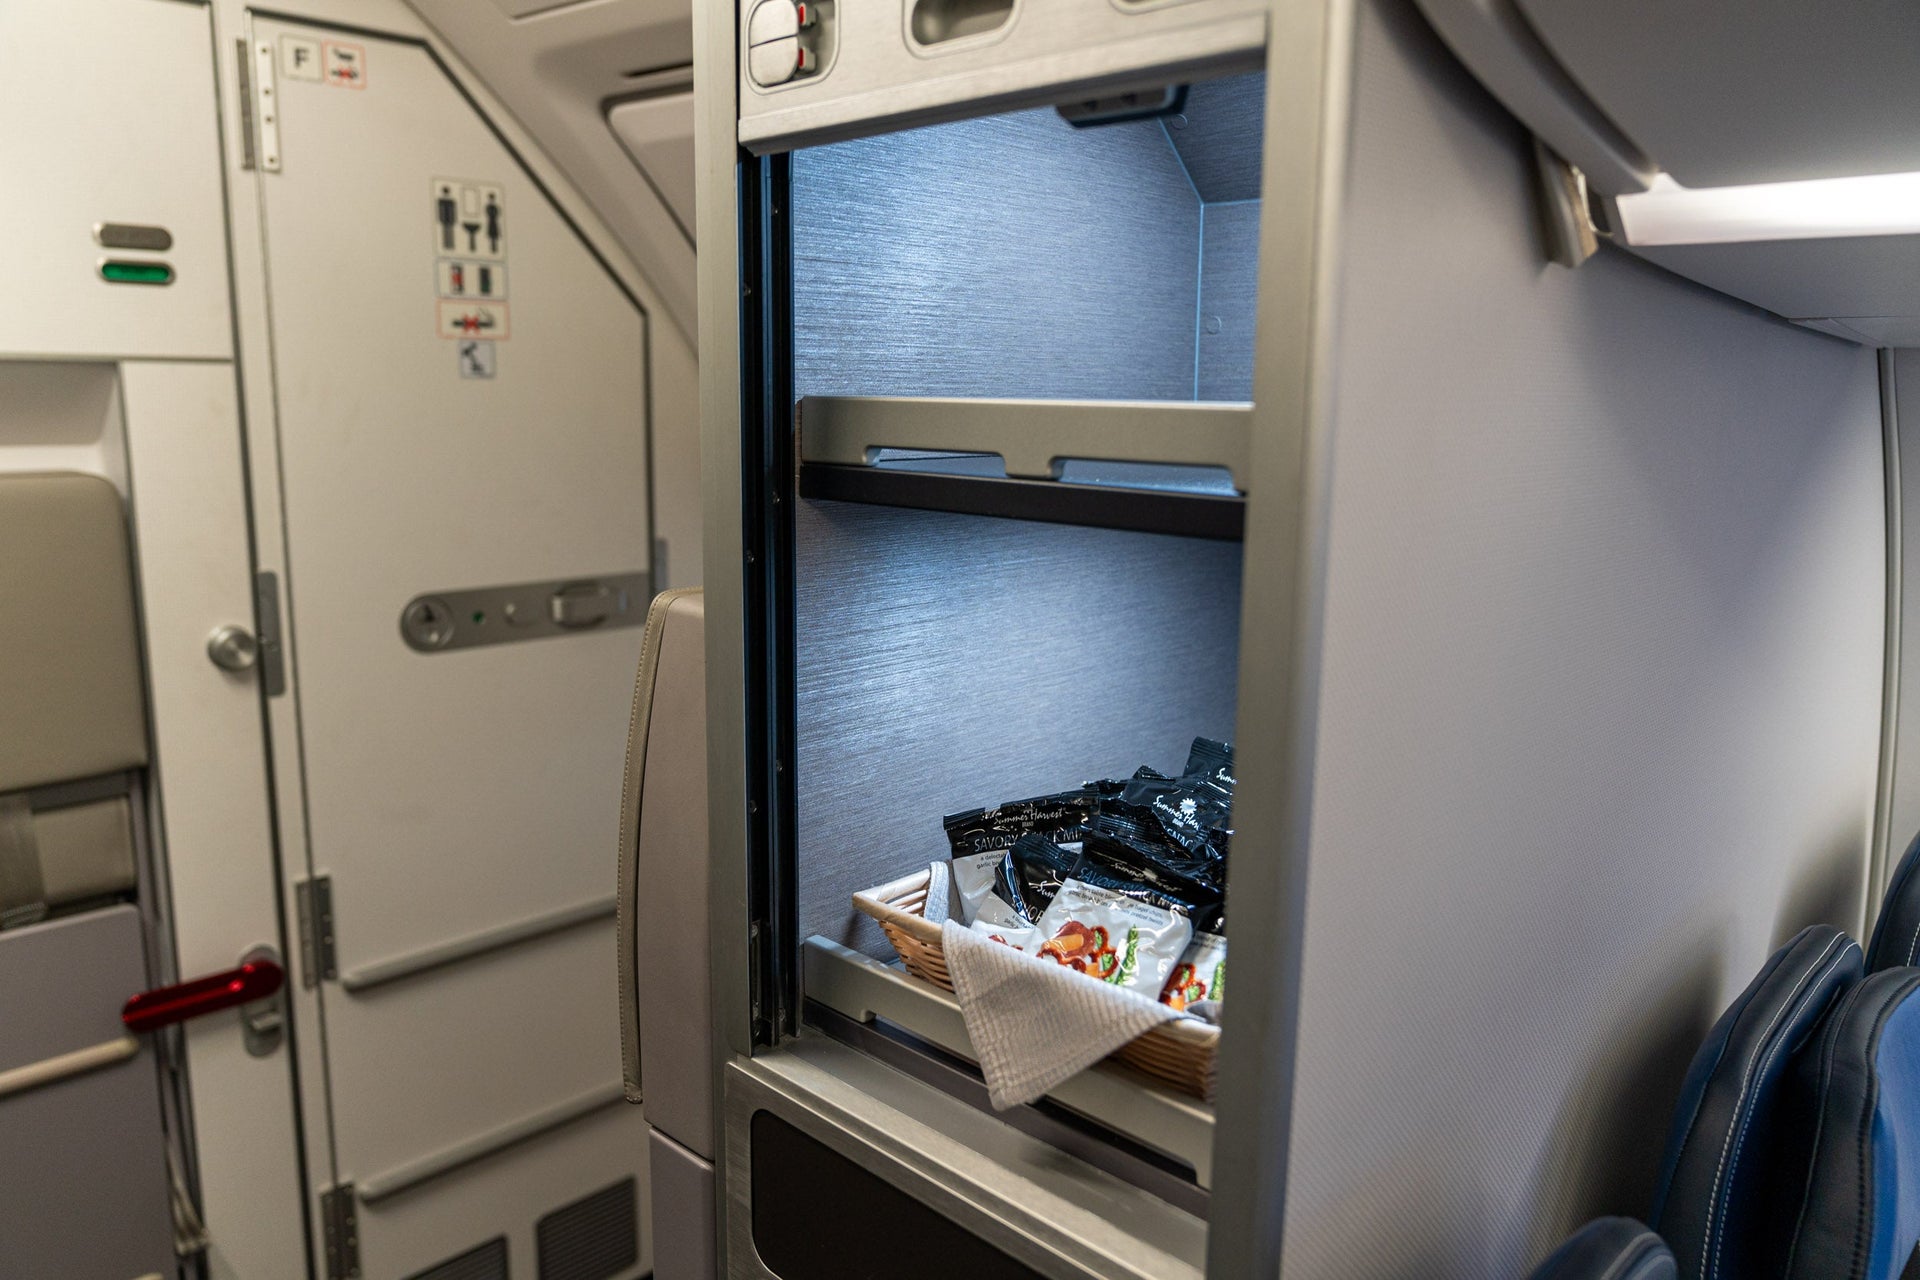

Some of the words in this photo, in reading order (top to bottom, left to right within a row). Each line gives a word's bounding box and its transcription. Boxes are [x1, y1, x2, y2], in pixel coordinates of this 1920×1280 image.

[294, 47, 309, 68] F
[994, 814, 1028, 825] Summer
[1029, 808, 1064, 820] Harvest
[1153, 795, 1182, 819] Summer
[974, 833, 1019, 852] SAVORY
[1077, 866, 1121, 888] SAVORY
